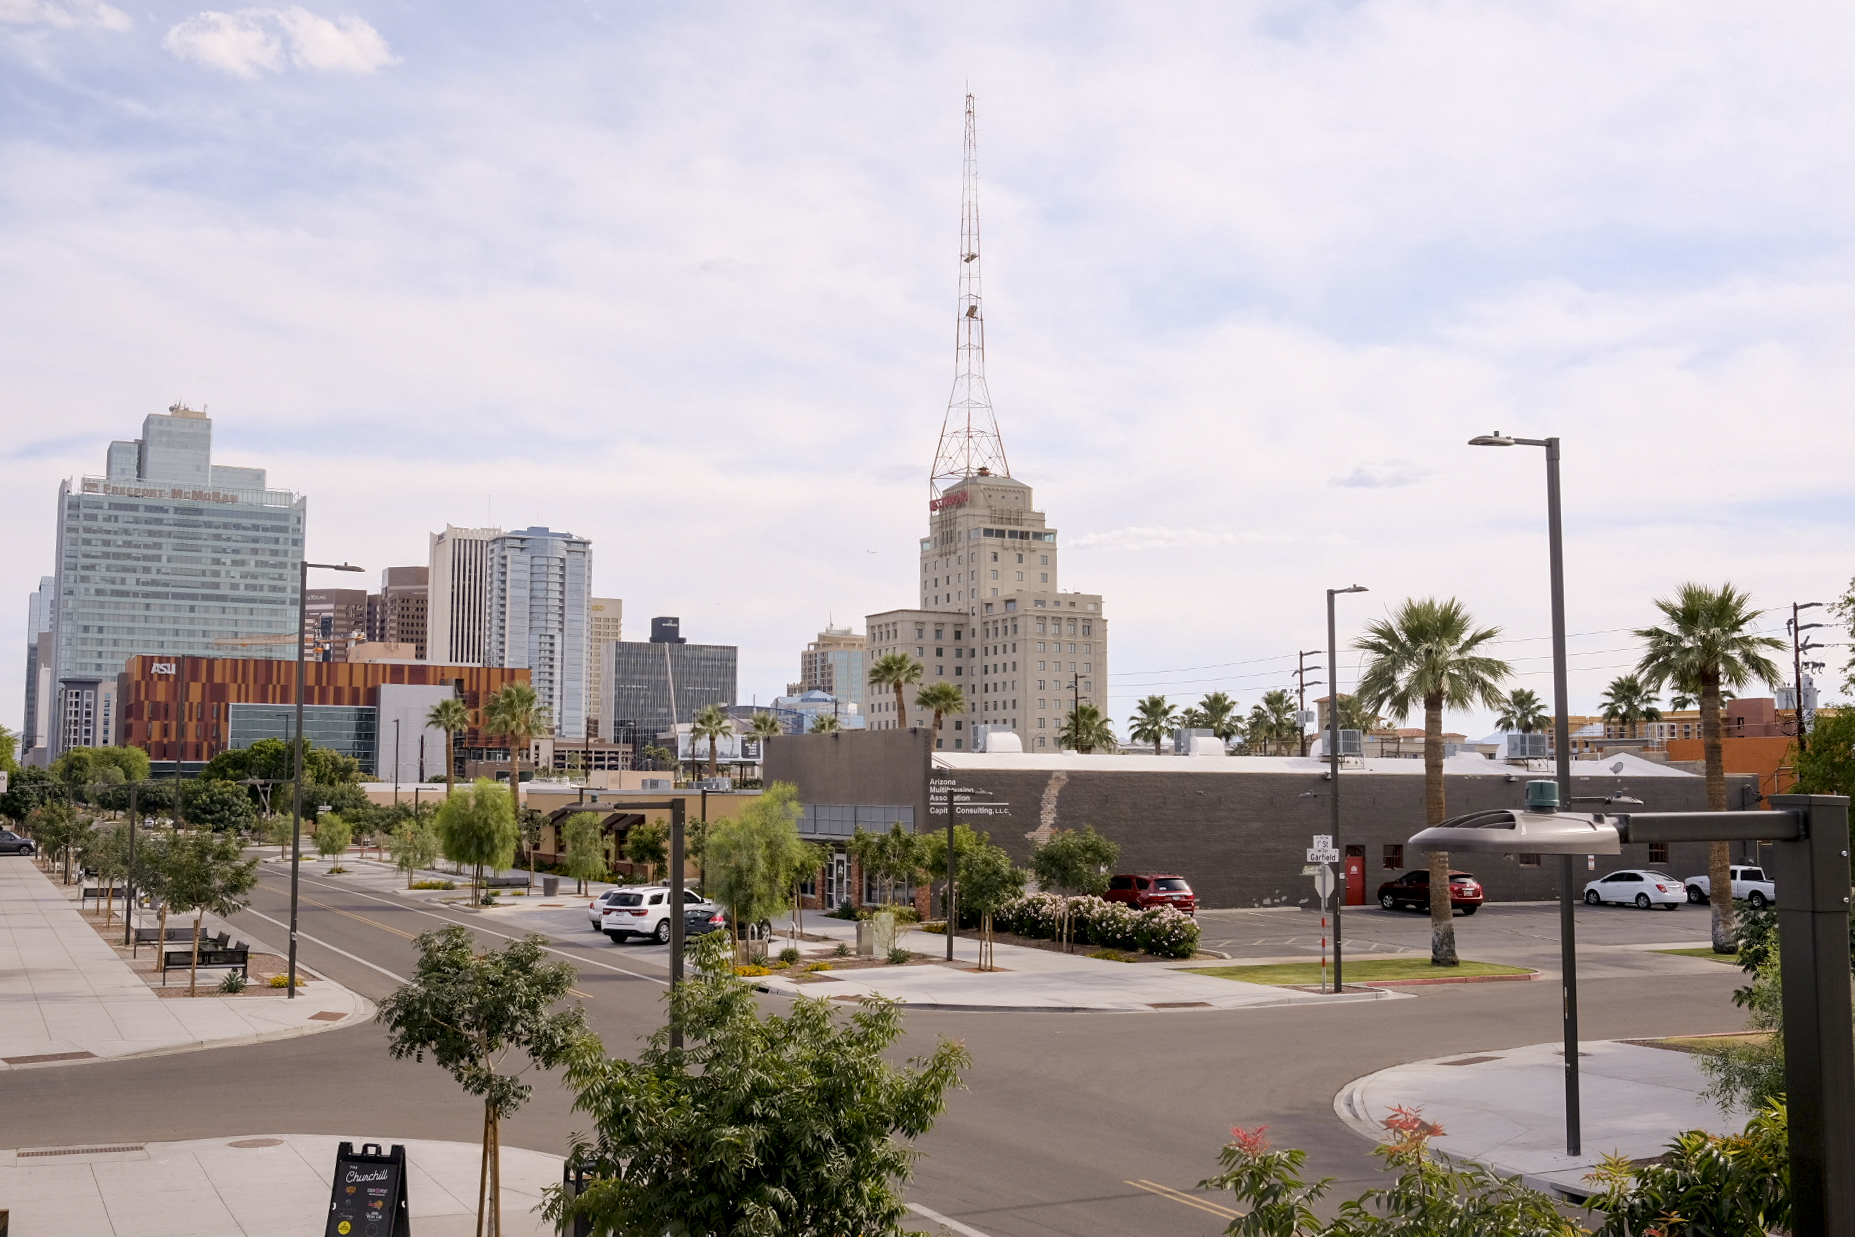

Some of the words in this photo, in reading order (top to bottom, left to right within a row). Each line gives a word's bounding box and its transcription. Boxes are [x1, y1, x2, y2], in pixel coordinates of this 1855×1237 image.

[151, 663, 176, 674] ASU
[929, 778, 956, 786] Arizona
[929, 794, 971, 802] Assoation
[929, 807, 950, 816] Capit
[1310, 853, 1336, 861] Garfield
[345, 1169, 388, 1183] Churchill
